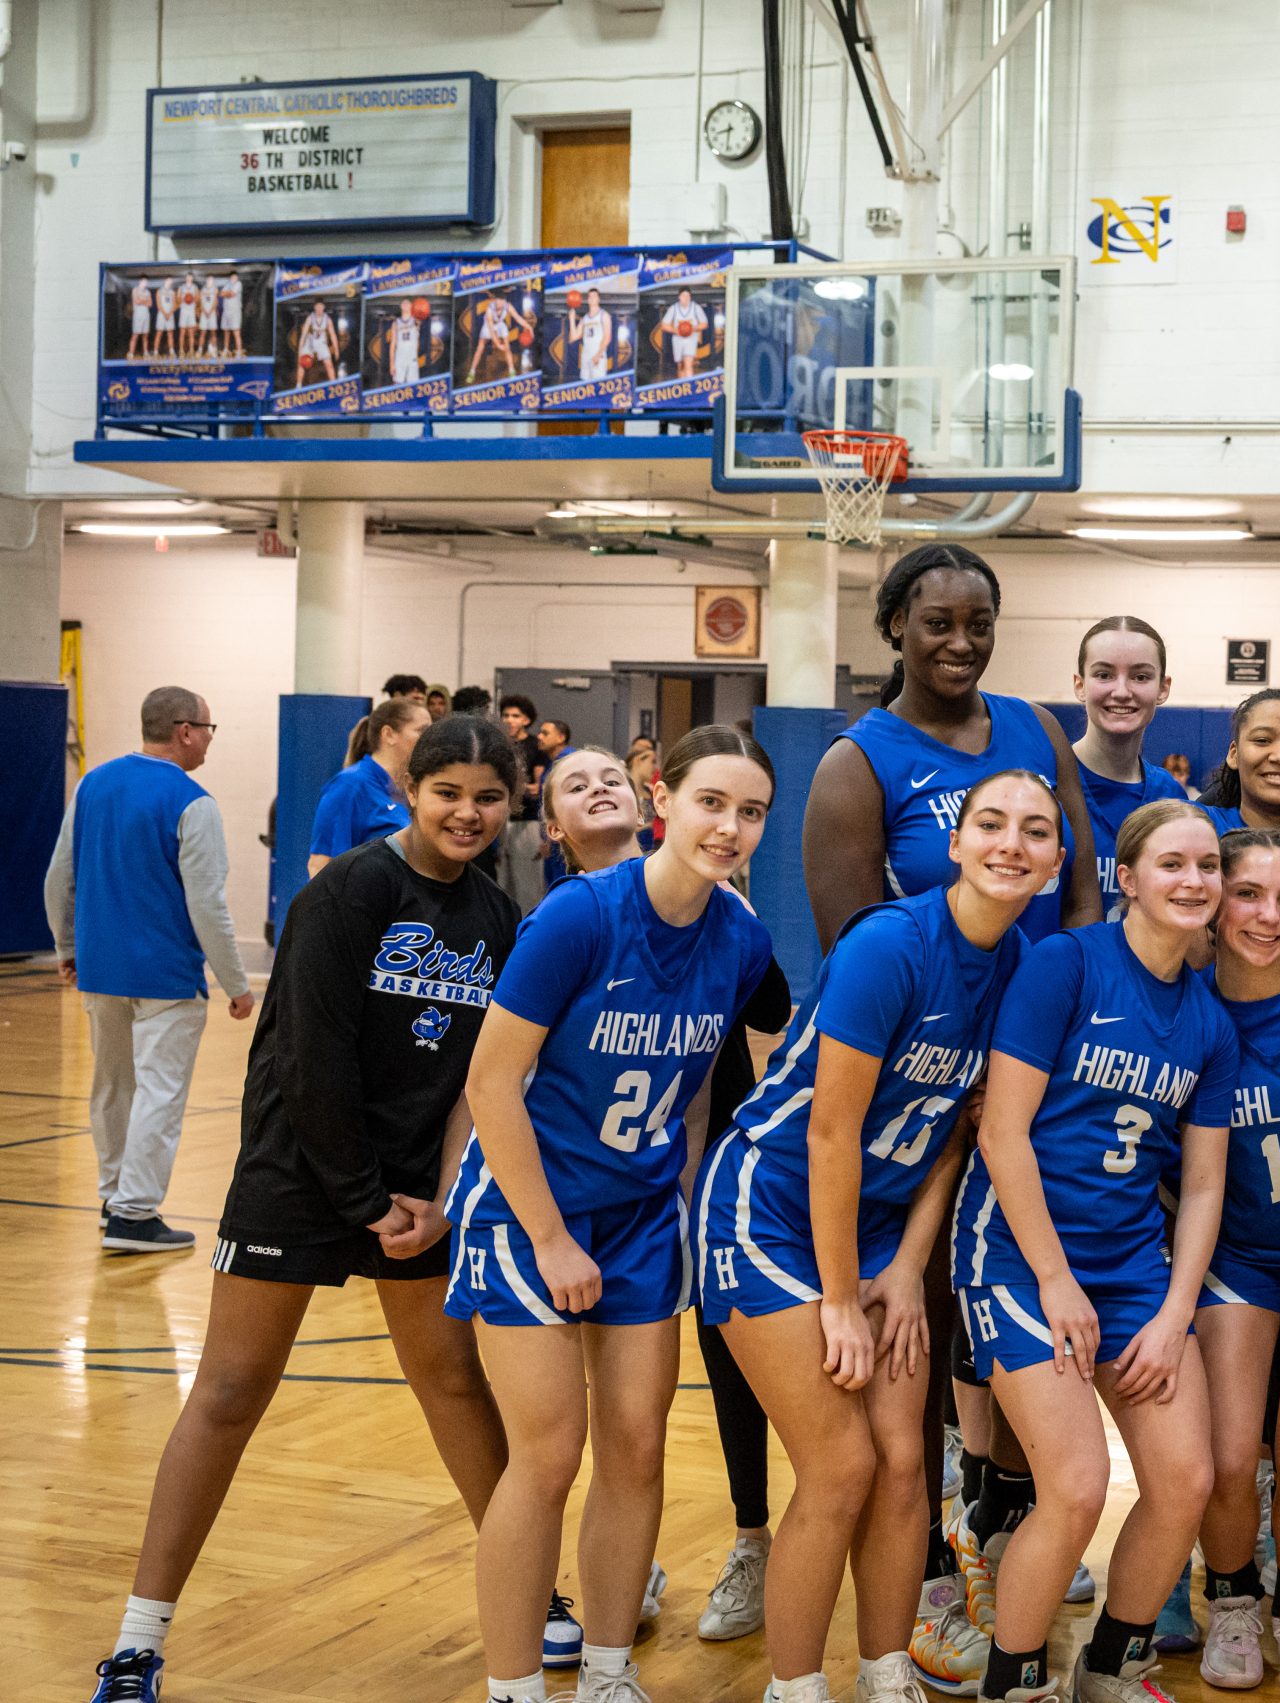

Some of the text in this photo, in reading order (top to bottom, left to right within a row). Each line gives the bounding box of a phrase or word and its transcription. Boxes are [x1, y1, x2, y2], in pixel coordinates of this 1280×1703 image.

[164, 87, 457, 118] NEWPORT CENTRAL CATHOLIC THOROUGHBREDS
[263, 126, 330, 146] WELCOME
[240, 148, 363, 170] 36 TH DISTRICT
[248, 172, 353, 192] BASKETBALL !
[276, 381, 357, 410] SENIOR 2025
[365, 380, 447, 408] SENIOR 2025
[454, 378, 538, 407] SENIOR 2025
[543, 376, 631, 407] SENIOR 2025
[639, 384, 692, 405] SENIOR
[374, 922, 494, 987] Birds
[588, 1011, 724, 1056] HIGHLANDS
[1072, 1042, 1199, 1109] HIGHLAND
[599, 1069, 684, 1153] 24
[1103, 1104, 1153, 1174] 3
[247, 1244, 282, 1256] adidas
[467, 1247, 487, 1291] H
[713, 1246, 739, 1291] H
[972, 1299, 999, 1342] H
